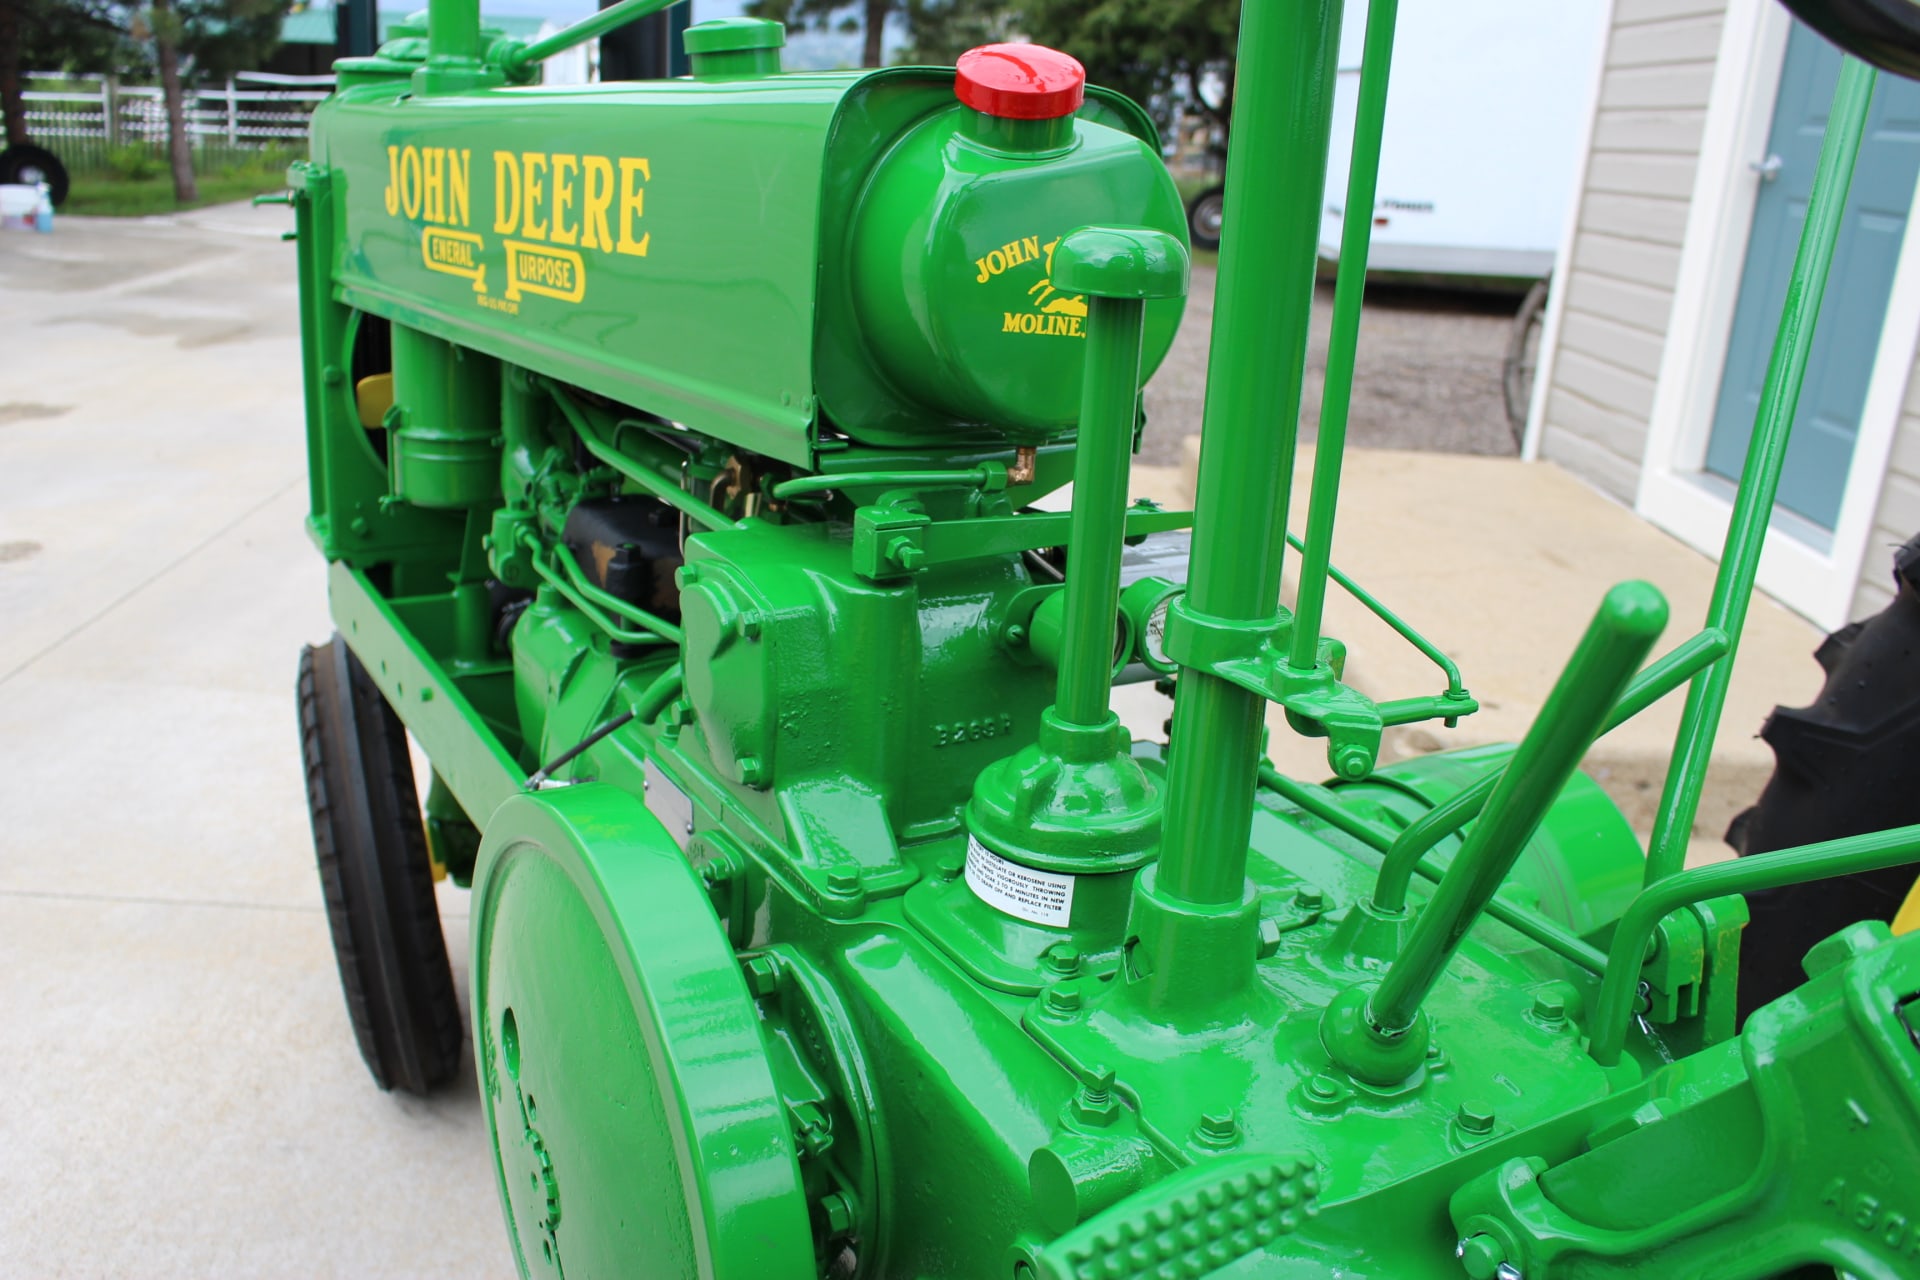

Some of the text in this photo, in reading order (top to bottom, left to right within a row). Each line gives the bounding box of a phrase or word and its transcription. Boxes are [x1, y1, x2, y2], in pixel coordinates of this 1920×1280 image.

[384, 145, 651, 257] JOHN DEERE
[975, 235, 1041, 284] JOHN
[997, 872, 1029, 889] VIGOROUSLY
[1033, 886, 1066, 897] THROWING
[1017, 874, 1046, 887] KEROSENE
[1047, 882, 1067, 890] USING
[1005, 892, 1016, 900] AND
[1018, 896, 1042, 908] REPLACE
[1044, 903, 1062, 911] FILTER
[1015, 888, 1039, 900] MINUTES
[1050, 897, 1065, 905] NEW
